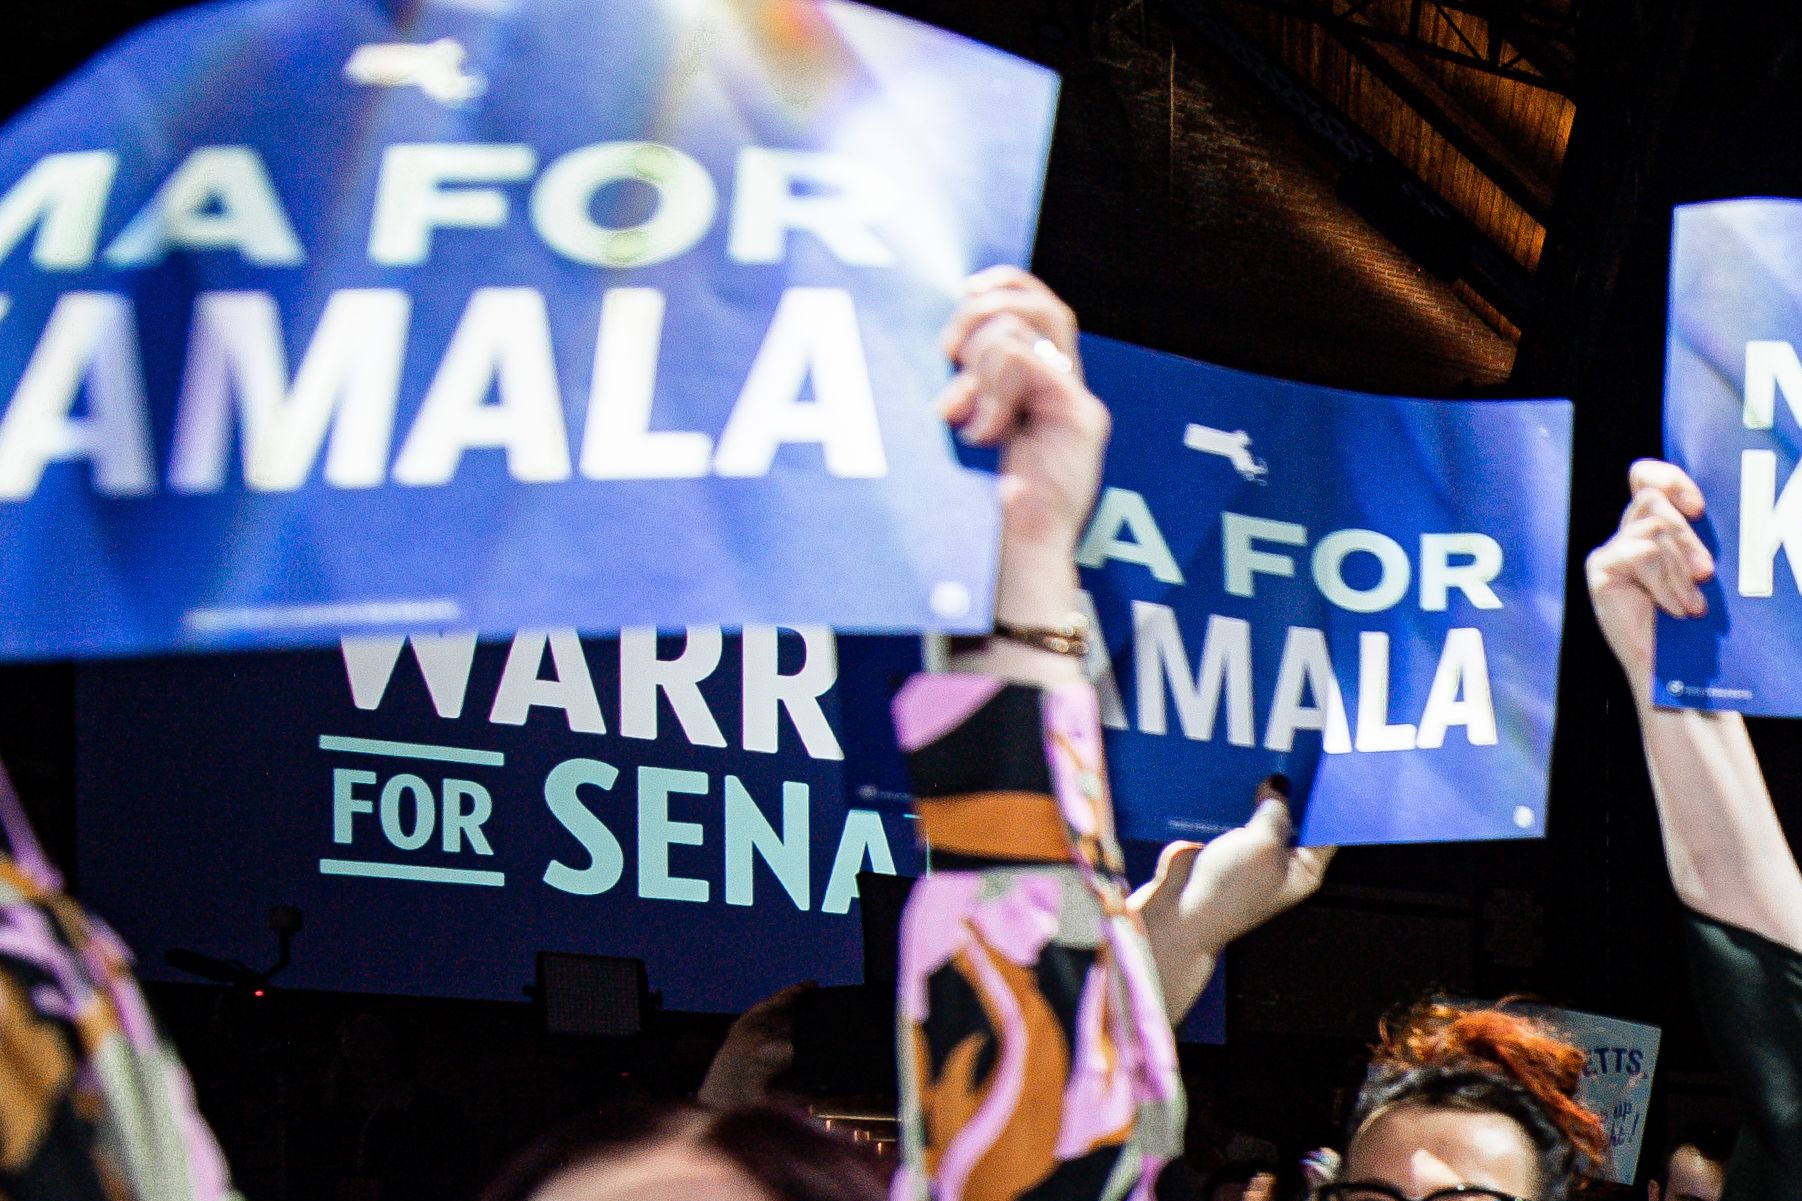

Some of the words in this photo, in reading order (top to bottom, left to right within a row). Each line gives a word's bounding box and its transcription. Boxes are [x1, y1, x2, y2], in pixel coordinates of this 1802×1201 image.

[367, 140, 898, 269] FOR
[0, 286, 888, 502] AMALA
[1221, 511, 1502, 612] FOR
[341, 625, 845, 762] WARR
[334, 768, 494, 856] FOR
[543, 757, 930, 915] SENA
